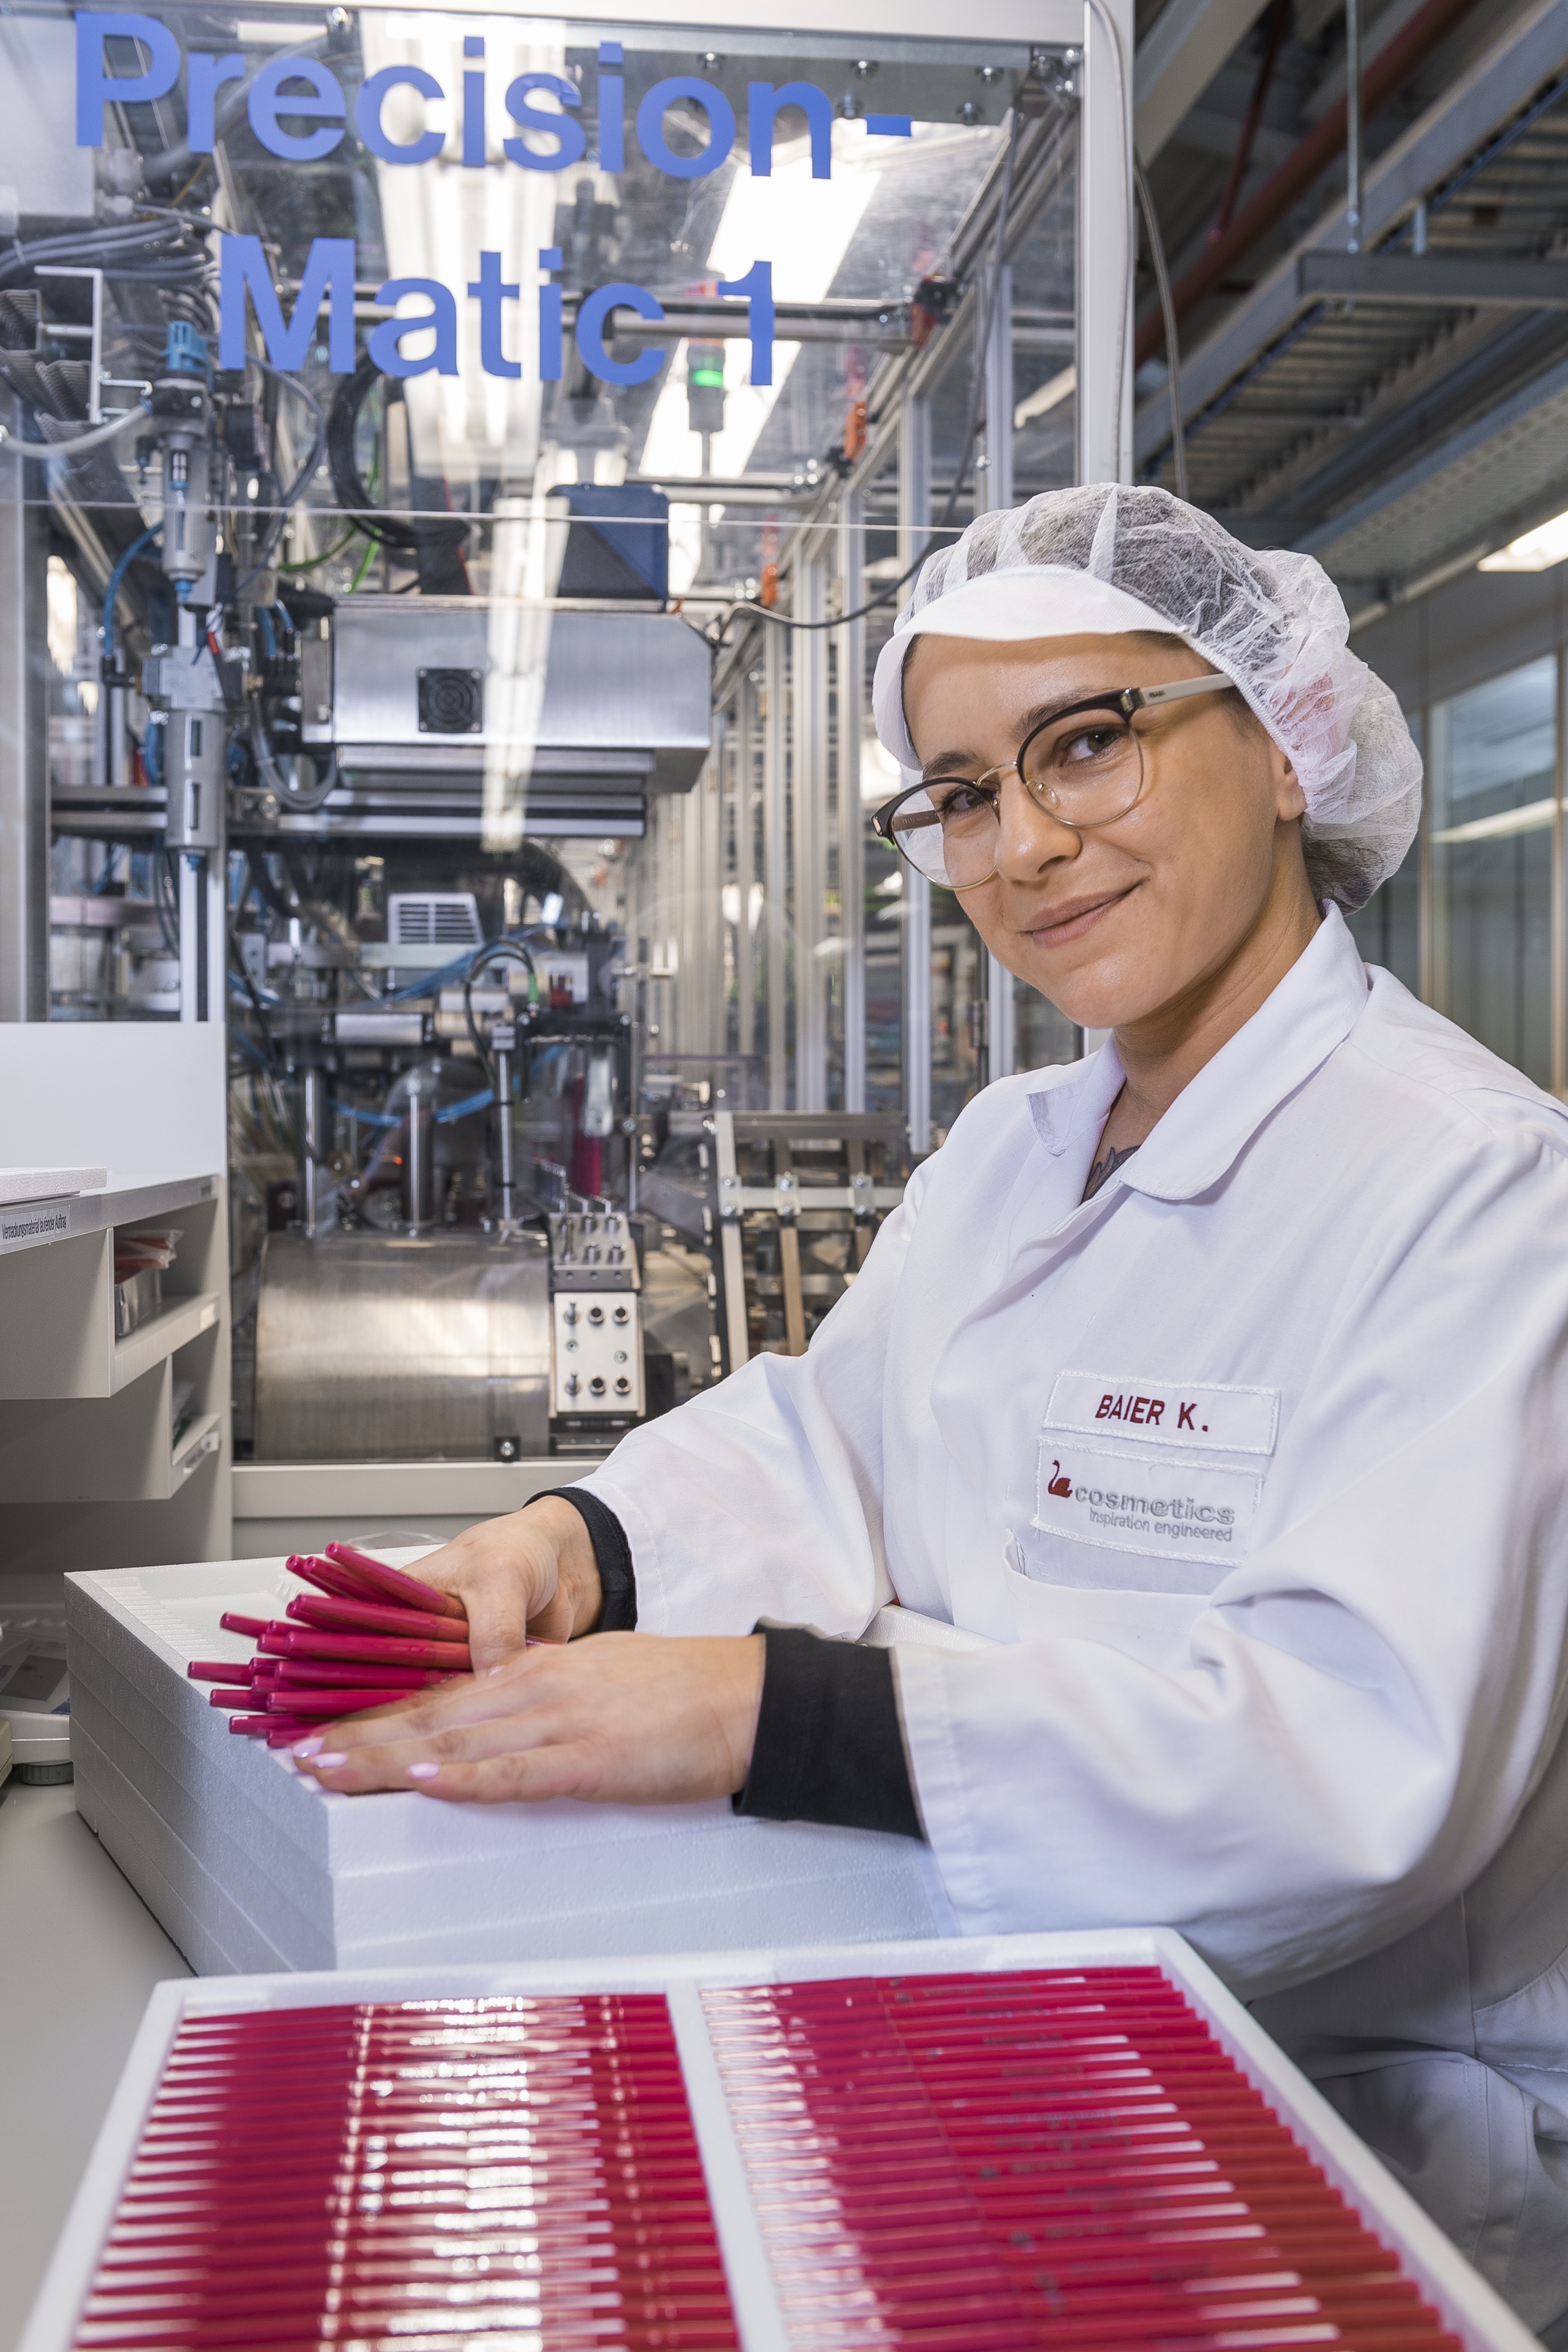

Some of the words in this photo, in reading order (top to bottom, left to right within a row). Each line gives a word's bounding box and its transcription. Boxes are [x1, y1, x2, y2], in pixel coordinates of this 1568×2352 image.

[74, 10, 913, 179] Precision-
[218, 234, 667, 386] Matic
[718, 260, 775, 385] 1
[55, 1214, 66, 1229] Auftrag
[1095, 1394, 1165, 1425] BAIER
[1177, 1402, 1209, 1432] K.
[1075, 1486, 1235, 1524] cosmetics
[1154, 1522, 1232, 1542] engineered
